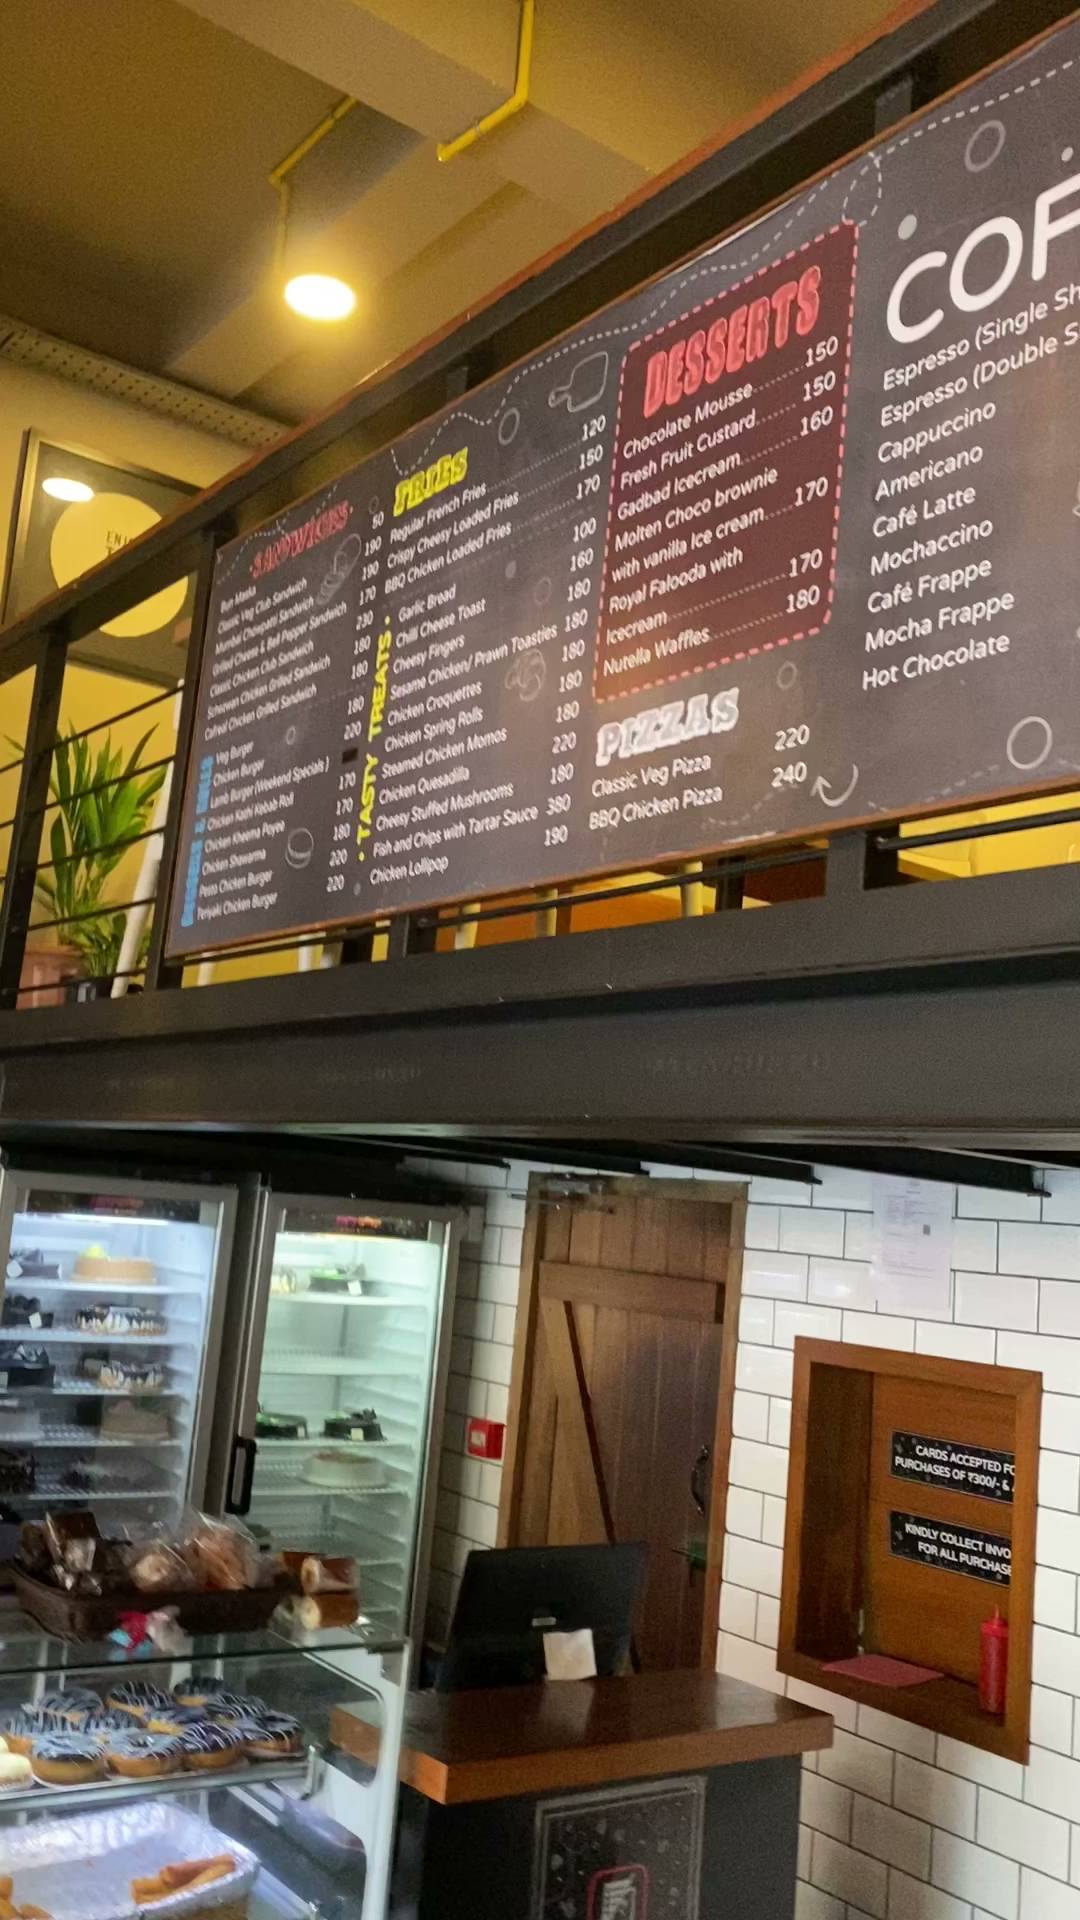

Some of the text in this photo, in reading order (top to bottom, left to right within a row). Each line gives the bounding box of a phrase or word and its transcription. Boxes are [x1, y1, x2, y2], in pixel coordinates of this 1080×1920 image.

[643, 265, 821, 418] DESSERTS
[883, 338, 970, 391] Espresso
[974, 302, 1048, 351] (Single
[623, 335, 839, 459] Chocolate Mousse 150
[880, 376, 968, 427] Espresso
[972, 336, 1058, 390] (Double
[617, 405, 834, 521] Gadbad Icecream 160
[620, 370, 836, 491] Fresh Fruit Custard 150
[878, 402, 997, 463] Cappuccino
[387, 444, 604, 569] Crispy Cheesy Loaded Fries 150
[389, 414, 607, 544] Regular French Fries 120
[393, 446, 468, 517] FRIES
[875, 445, 984, 501] Americano
[923, 487, 976, 520] Latte
[372, 511, 385, 530] 50
[384, 474, 601, 594] BBQ Chicken Loaded Fries 170
[611, 476, 829, 583] with vanilla Ice cream 170
[614, 467, 778, 552] Molten Choco brownie
[398, 517, 597, 623] Garlic Bread 100
[609, 546, 743, 614] Royal Falooda with
[870, 519, 993, 576] Mochaccino
[917, 559, 992, 598] Frappe
[355, 609, 374, 631] 230
[359, 585, 377, 606] 170
[392, 577, 591, 675] Cheesy Fingers 180
[419, 612, 456, 638] Cheese
[457, 598, 486, 622] Toast
[570, 547, 594, 572] 160
[606, 548, 823, 646] Icecream 170
[865, 592, 1015, 652] Mocha Frappe
[353, 634, 371, 656] 180
[390, 676, 427, 701] Sesame
[474, 643, 509, 668] Prawn
[511, 624, 558, 654] Toasties
[564, 608, 589, 633] 180
[603, 584, 821, 677] Nutella Waffles 180
[862, 635, 1011, 691] Hot Chocolate
[351, 659, 369, 680] 180
[387, 702, 425, 726] Chicken
[561, 639, 586, 663] 180
[343, 720, 362, 740] 220
[347, 695, 365, 715] 180
[357, 630, 392, 845] TASTY TREATS
[381, 751, 424, 779] Steamed
[424, 741, 465, 765] Chicken
[556, 700, 580, 724] 180
[384, 669, 583, 753] Chicken Spring Rolls 180
[595, 687, 740, 767] PIZZAS
[338, 771, 357, 791] 170
[378, 783, 417, 805] Chicken
[552, 731, 577, 754] 220
[589, 761, 808, 830] BBQ Chicken Pizza 240
[591, 724, 810, 798] Classic Veg Pizza 220
[336, 796, 354, 816] 170
[375, 762, 574, 832] Cheesy Stuffed Mushrooms 180
[329, 848, 348, 867] 220
[369, 865, 408, 885] Chicken
[544, 824, 569, 847] 190
[373, 839, 393, 858] Fish
[393, 833, 413, 853] and
[413, 829, 442, 849] Chips
[443, 821, 466, 841] with
[468, 815, 502, 834] Tartar
[502, 806, 539, 827] Sauce
[326, 874, 345, 893] 220
[894, 1456, 951, 1478] PURCHASES
[952, 1468, 966, 1481] OF
[915, 1445, 949, 1461] CARDS
[950, 1453, 1002, 1473] ACCEPTED
[905, 1523, 939, 1540] KINDLY
[940, 1531, 984, 1552] COLLECT
[918, 1541, 938, 1556] FOR
[939, 1548, 958, 1562] ALL
